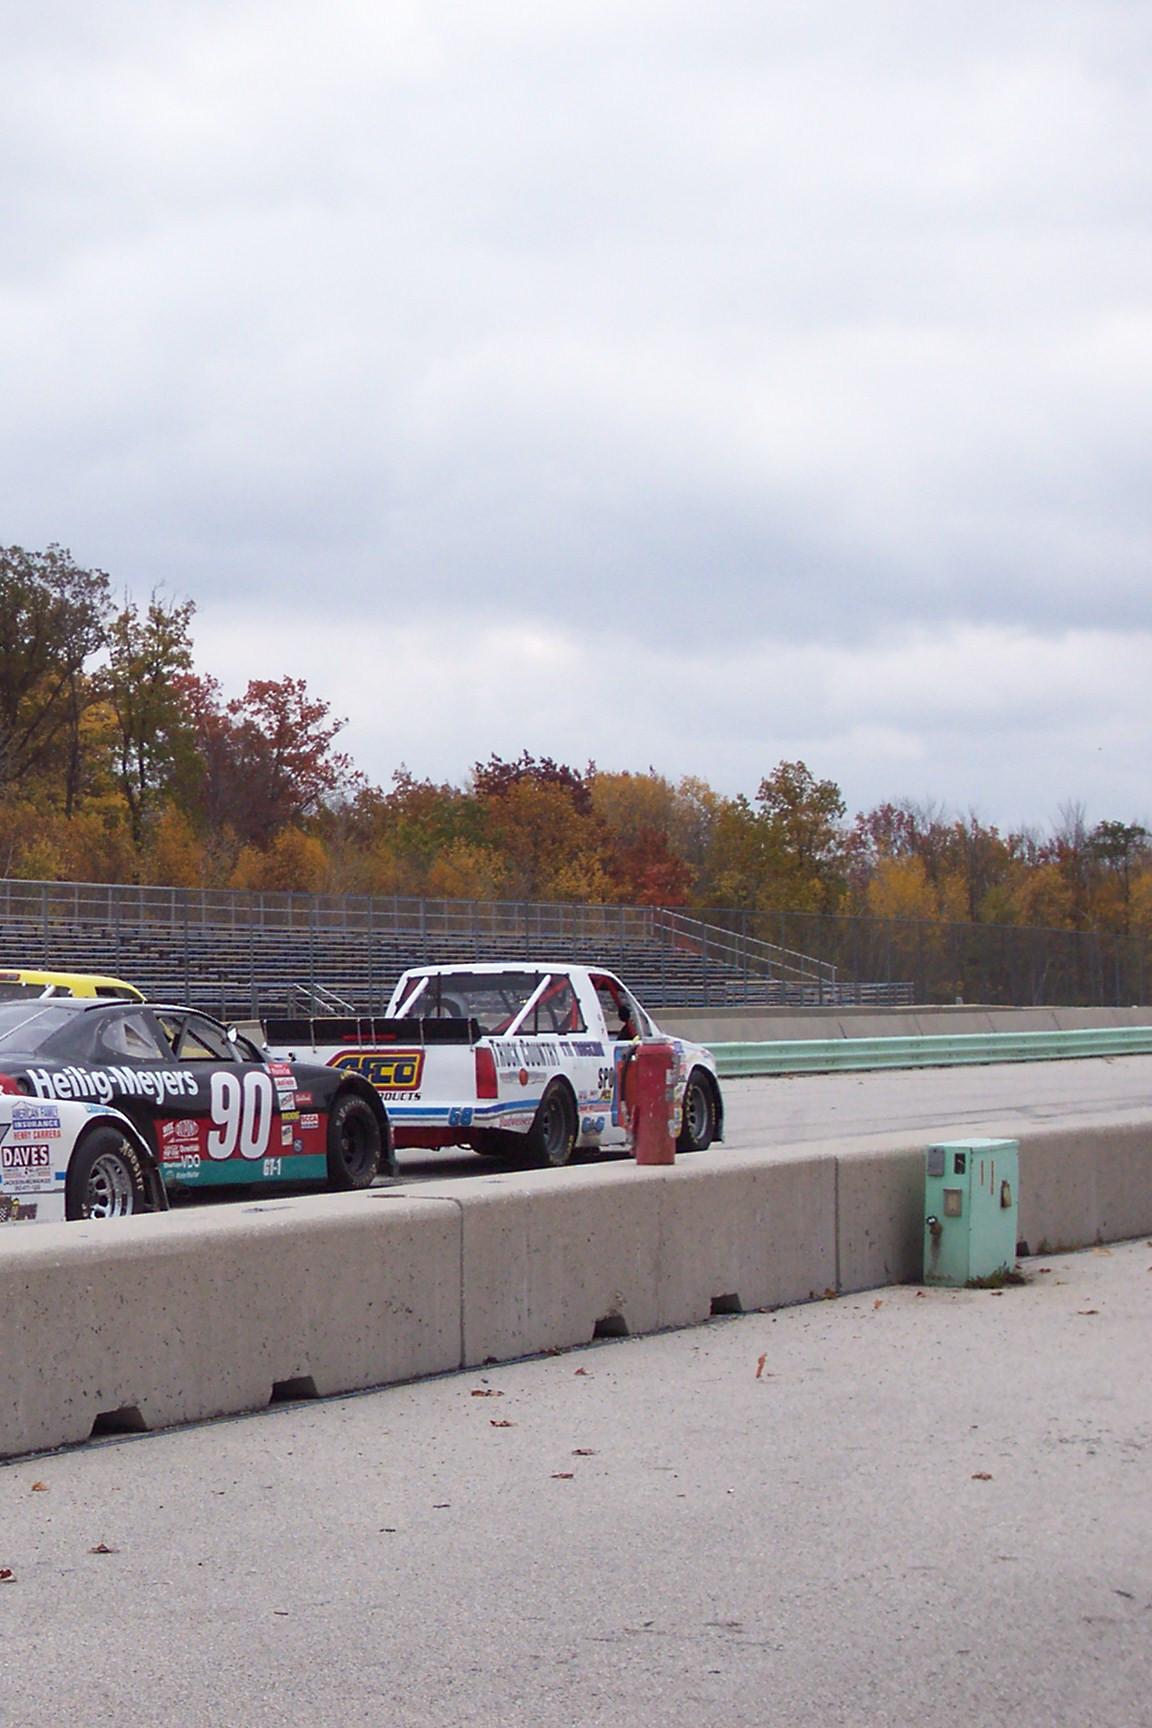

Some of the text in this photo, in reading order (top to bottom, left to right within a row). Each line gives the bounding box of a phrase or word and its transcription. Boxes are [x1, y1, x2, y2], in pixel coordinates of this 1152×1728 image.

[26, 1065, 199, 1106] Heilig-Meyers
[206, 1070, 274, 1161] 90
[262, 1157, 282, 1177] GT-1
